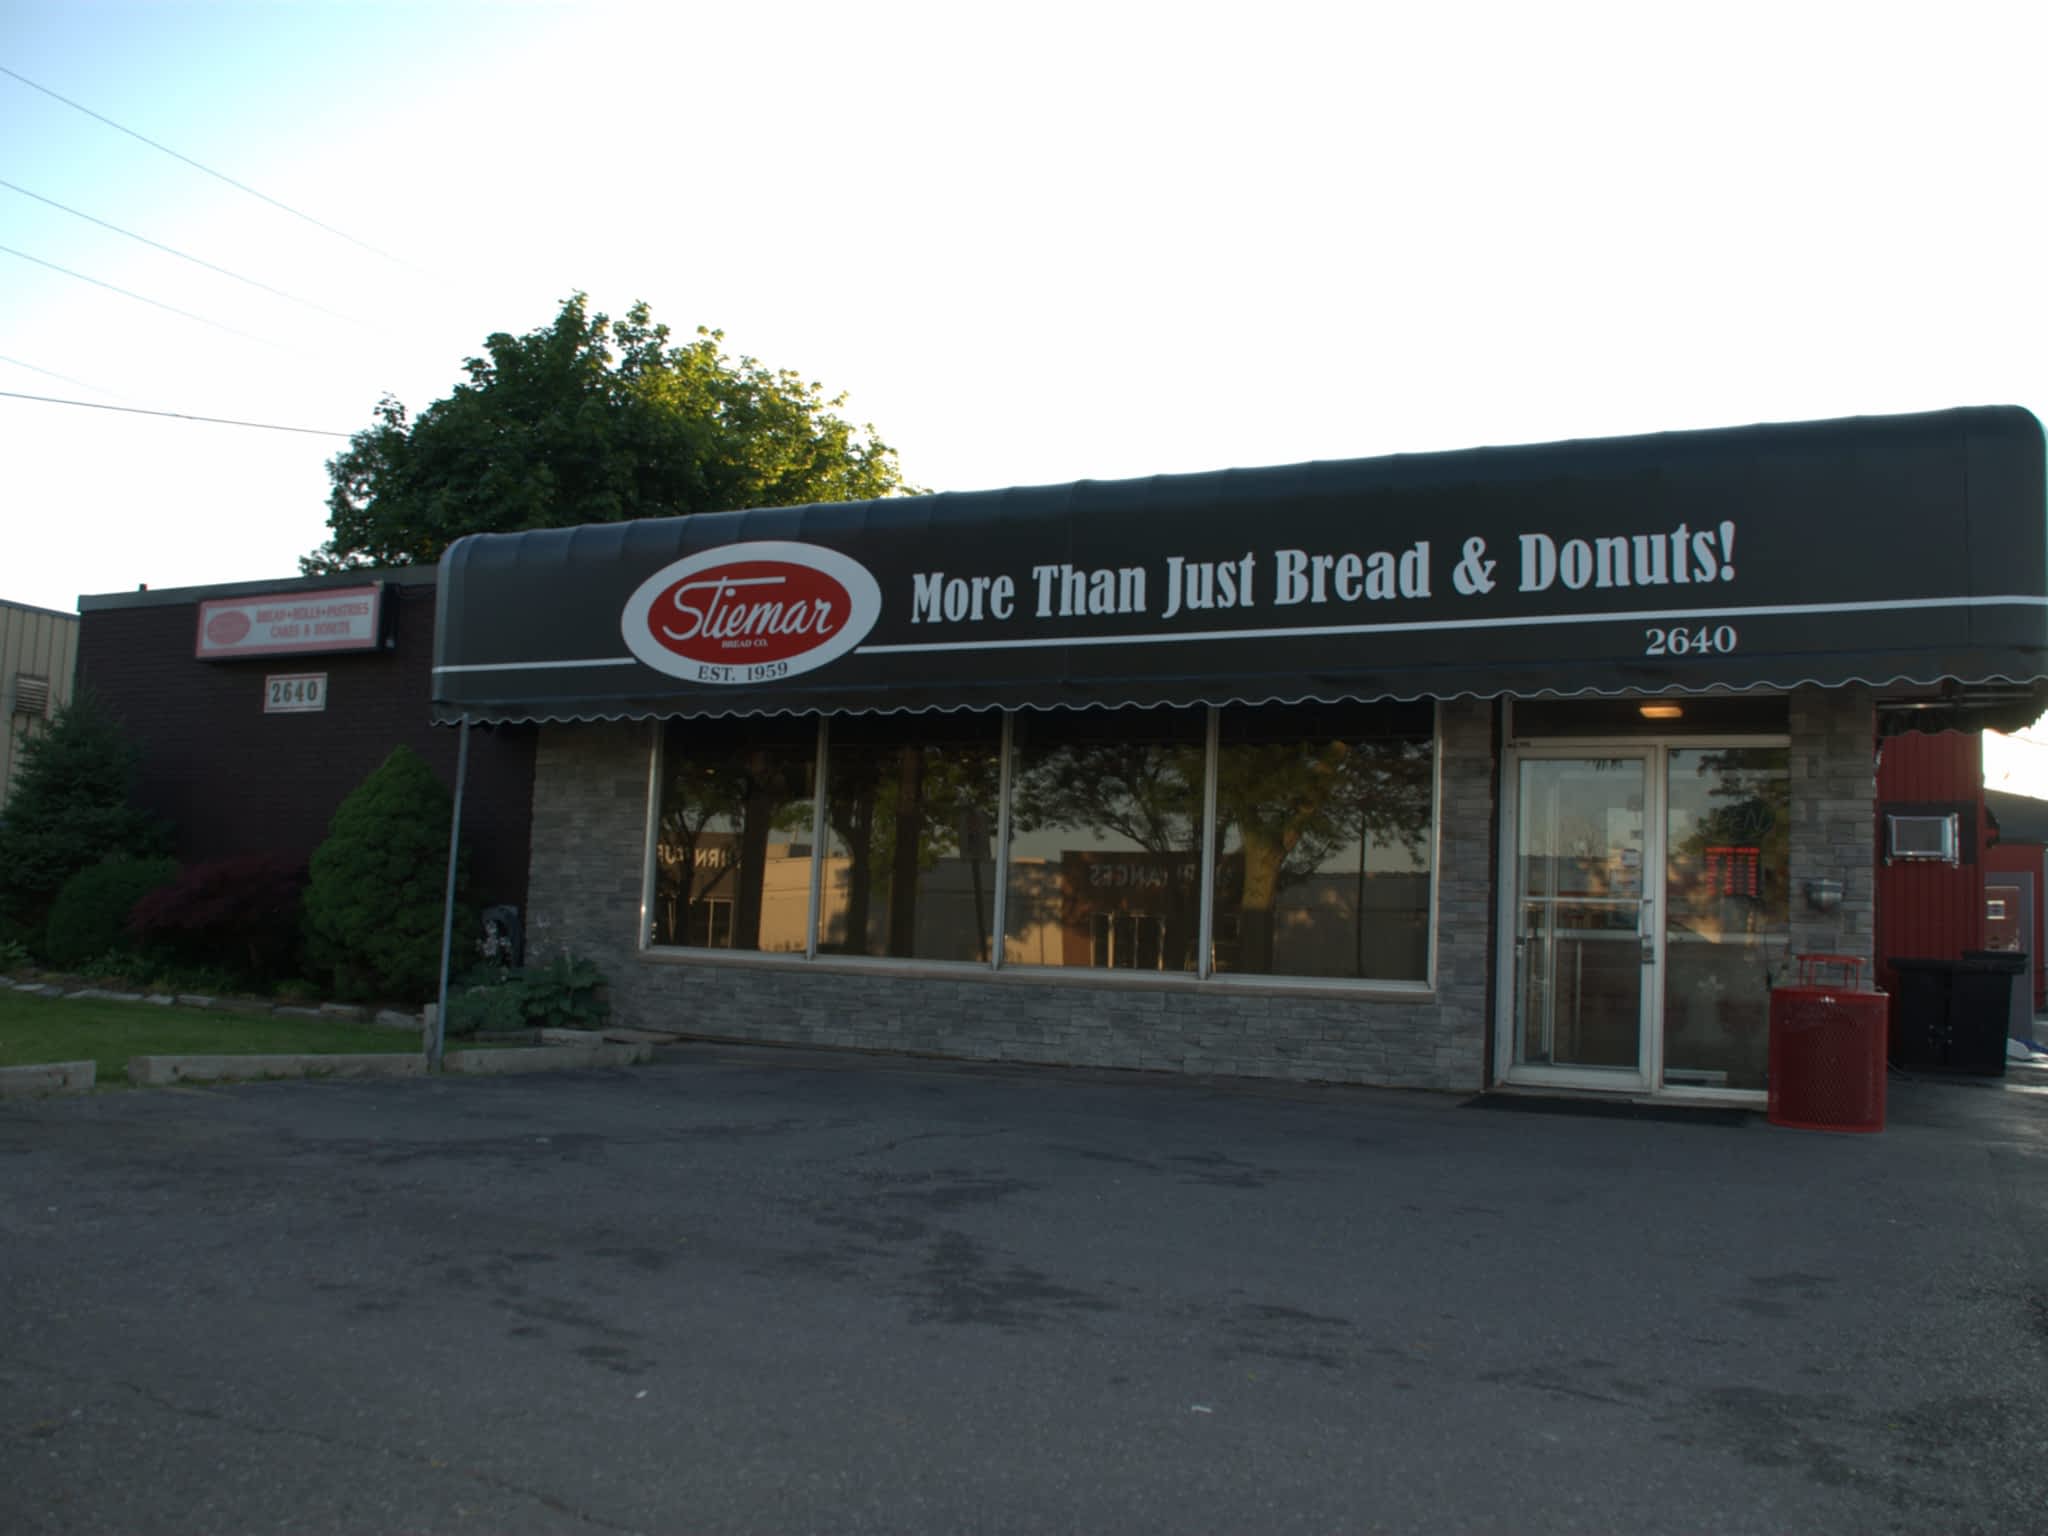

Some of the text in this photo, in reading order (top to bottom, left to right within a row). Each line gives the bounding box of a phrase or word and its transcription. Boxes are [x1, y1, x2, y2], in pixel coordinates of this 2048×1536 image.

[911, 520, 1737, 624] More Than Just Bread & Donuts!
[662, 575, 833, 641] Stiemar
[721, 639, 752, 649] BREAD
[1644, 625, 1737, 656] 2640
[697, 662, 788, 681] EST. 1959
[271, 681, 318, 703] 2640
